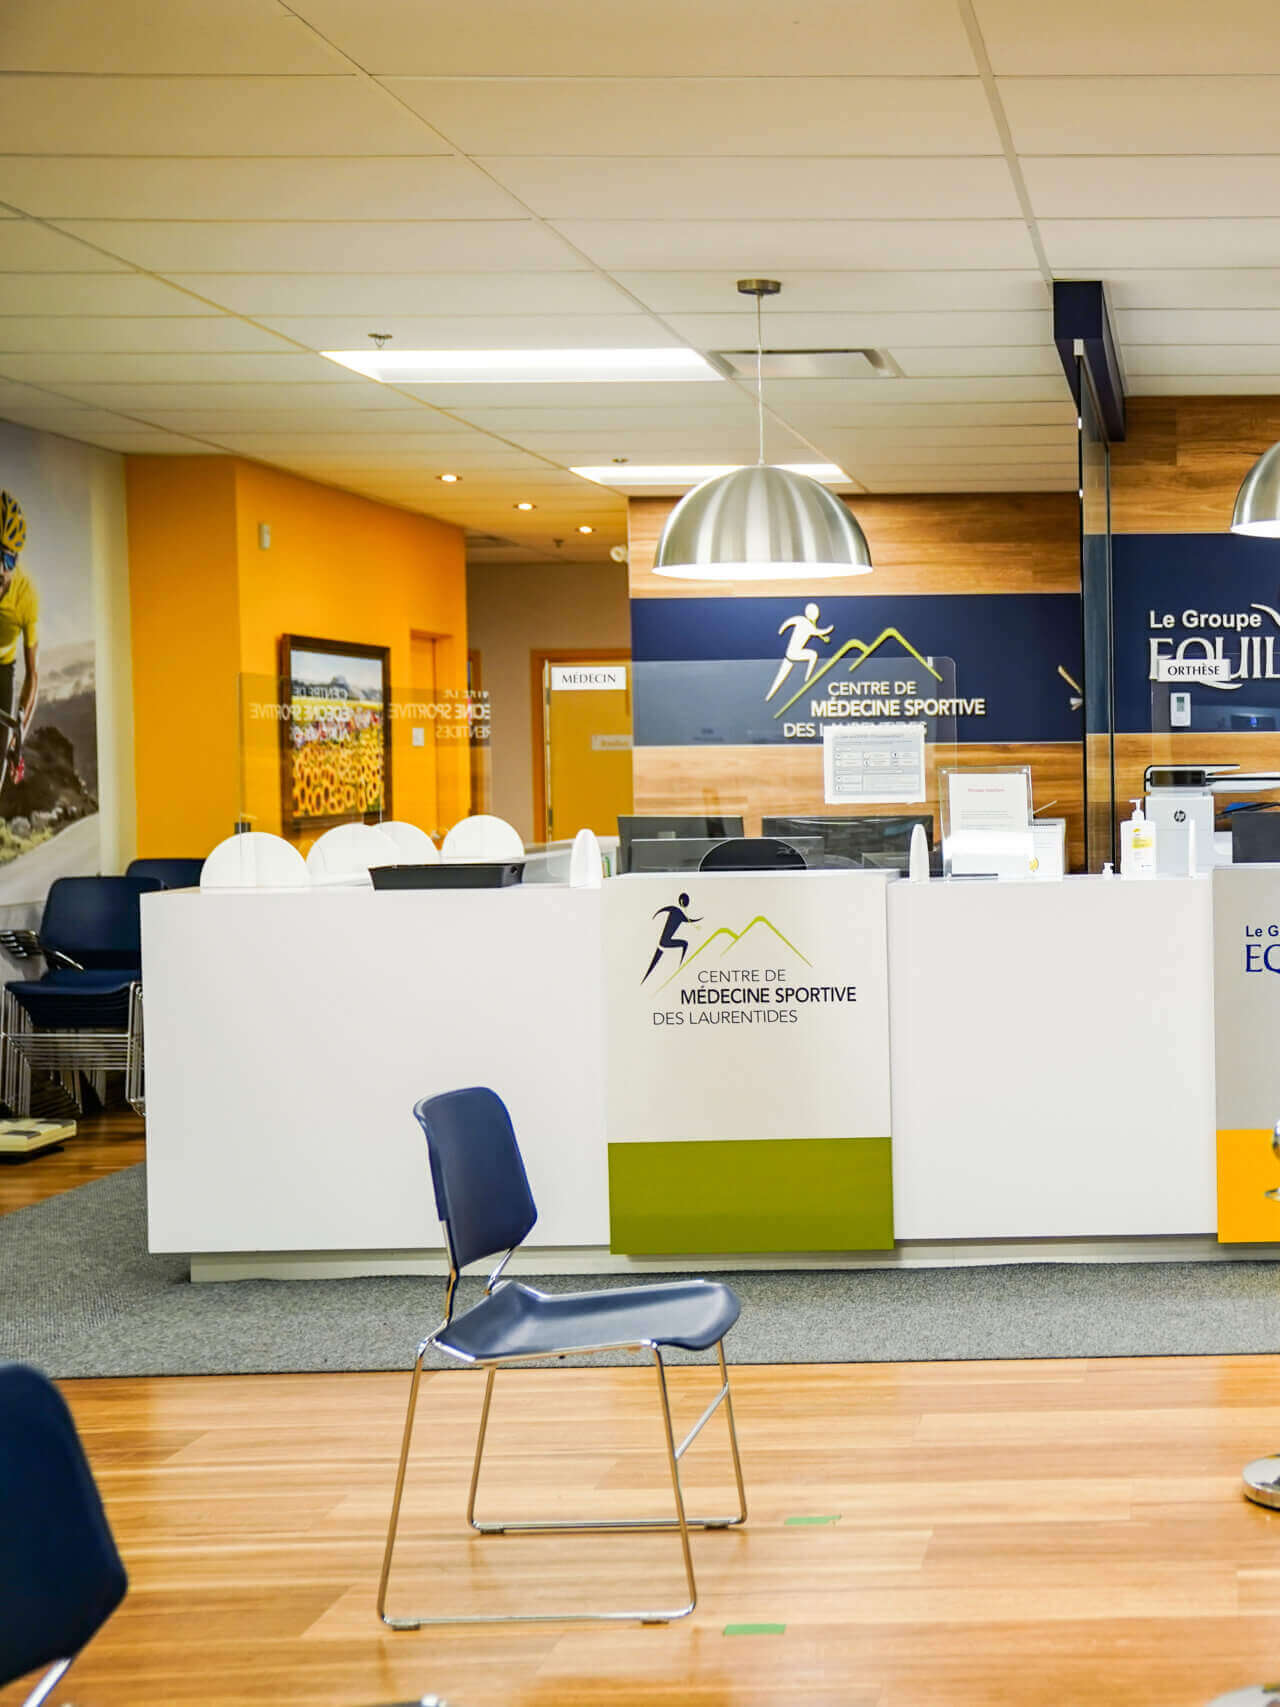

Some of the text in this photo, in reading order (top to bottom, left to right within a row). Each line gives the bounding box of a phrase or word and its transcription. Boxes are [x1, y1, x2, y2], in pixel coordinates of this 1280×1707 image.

[1149, 609, 1263, 632] Le Groupe
[1167, 662, 1221, 676] ORTHÈSE
[827, 681, 917, 697] CENTRE DE
[810, 696, 986, 718] MÉDECINE SPORTIVE
[783, 722, 816, 738] DES
[1245, 925, 1263, 938] Le
[697, 968, 787, 983] CENTRE DE
[680, 985, 857, 1005] MÉDECINE SPORTIVE
[652, 1009, 799, 1026] DES LAURENTIDES
